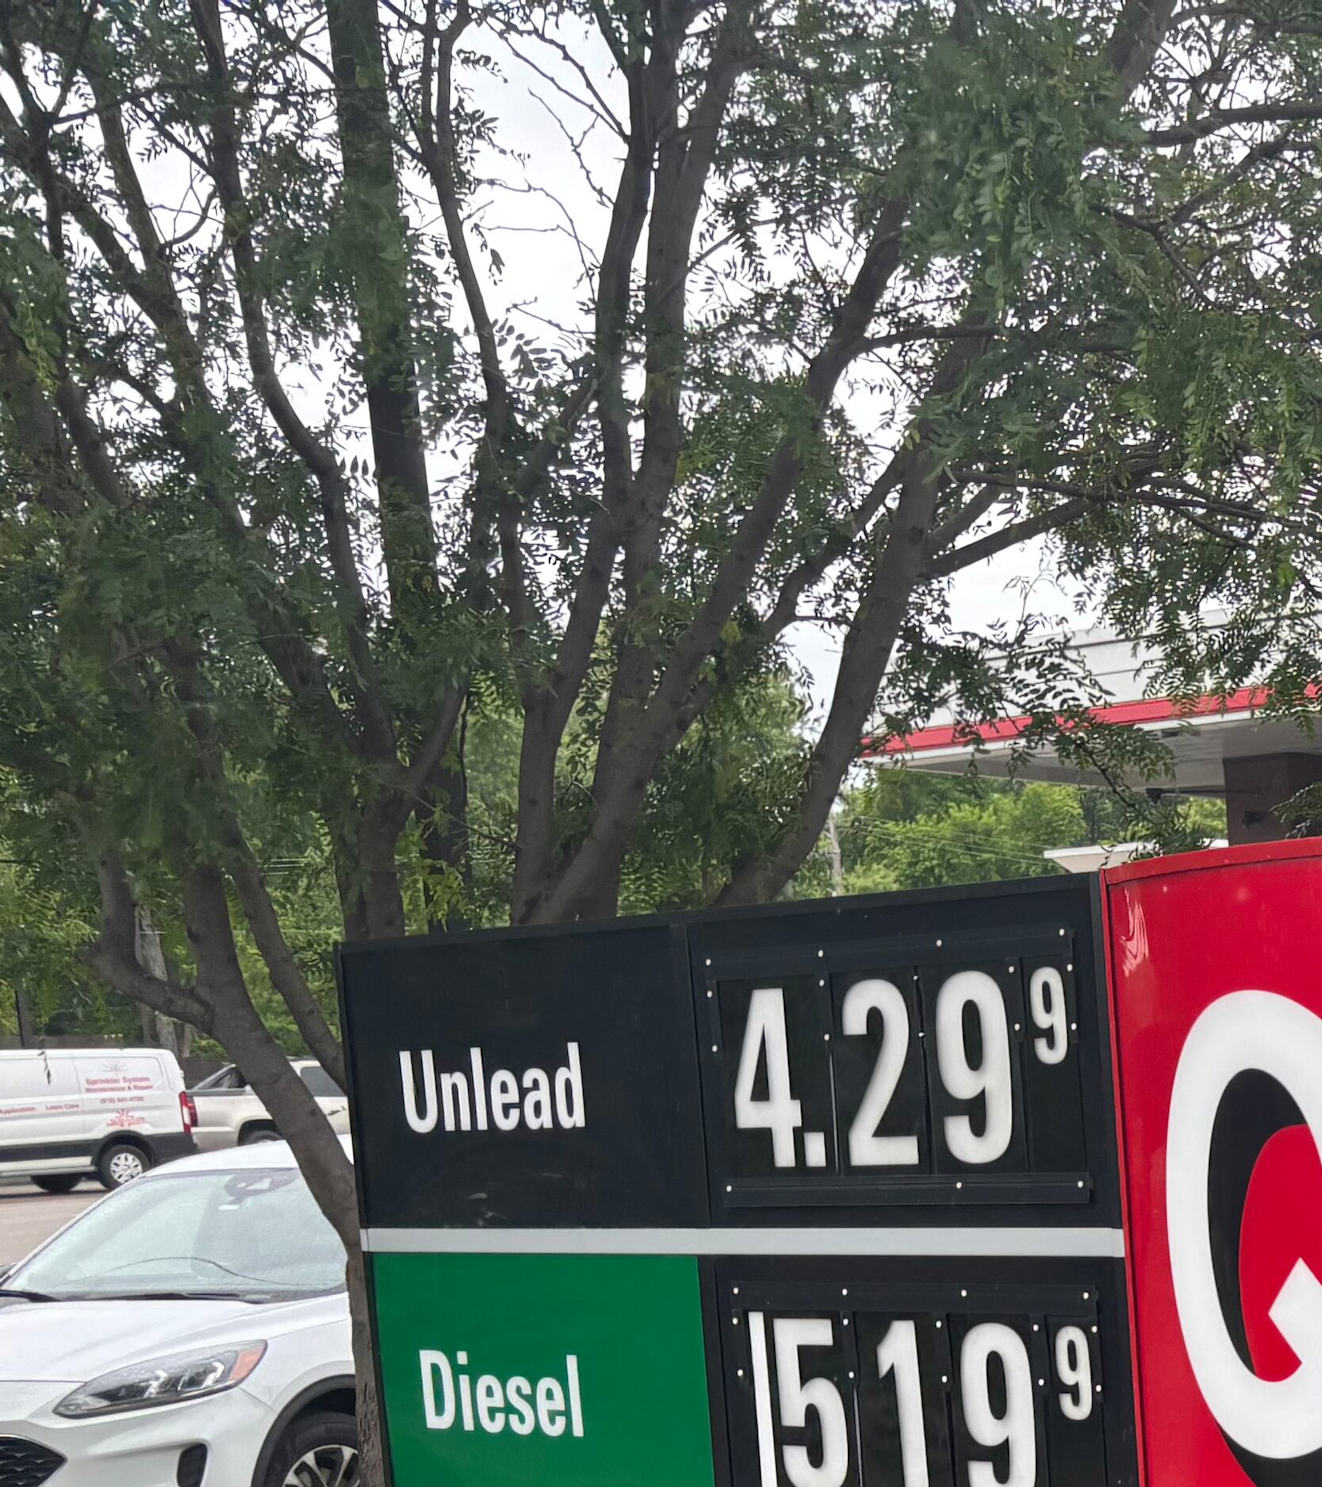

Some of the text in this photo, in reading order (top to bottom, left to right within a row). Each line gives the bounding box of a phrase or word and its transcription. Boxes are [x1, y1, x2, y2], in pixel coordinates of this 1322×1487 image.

[399, 966, 1068, 1168] Unlead 4.29 9
[418, 1349, 585, 1438] Diesel
[1055, 1325, 1093, 1422] 9
